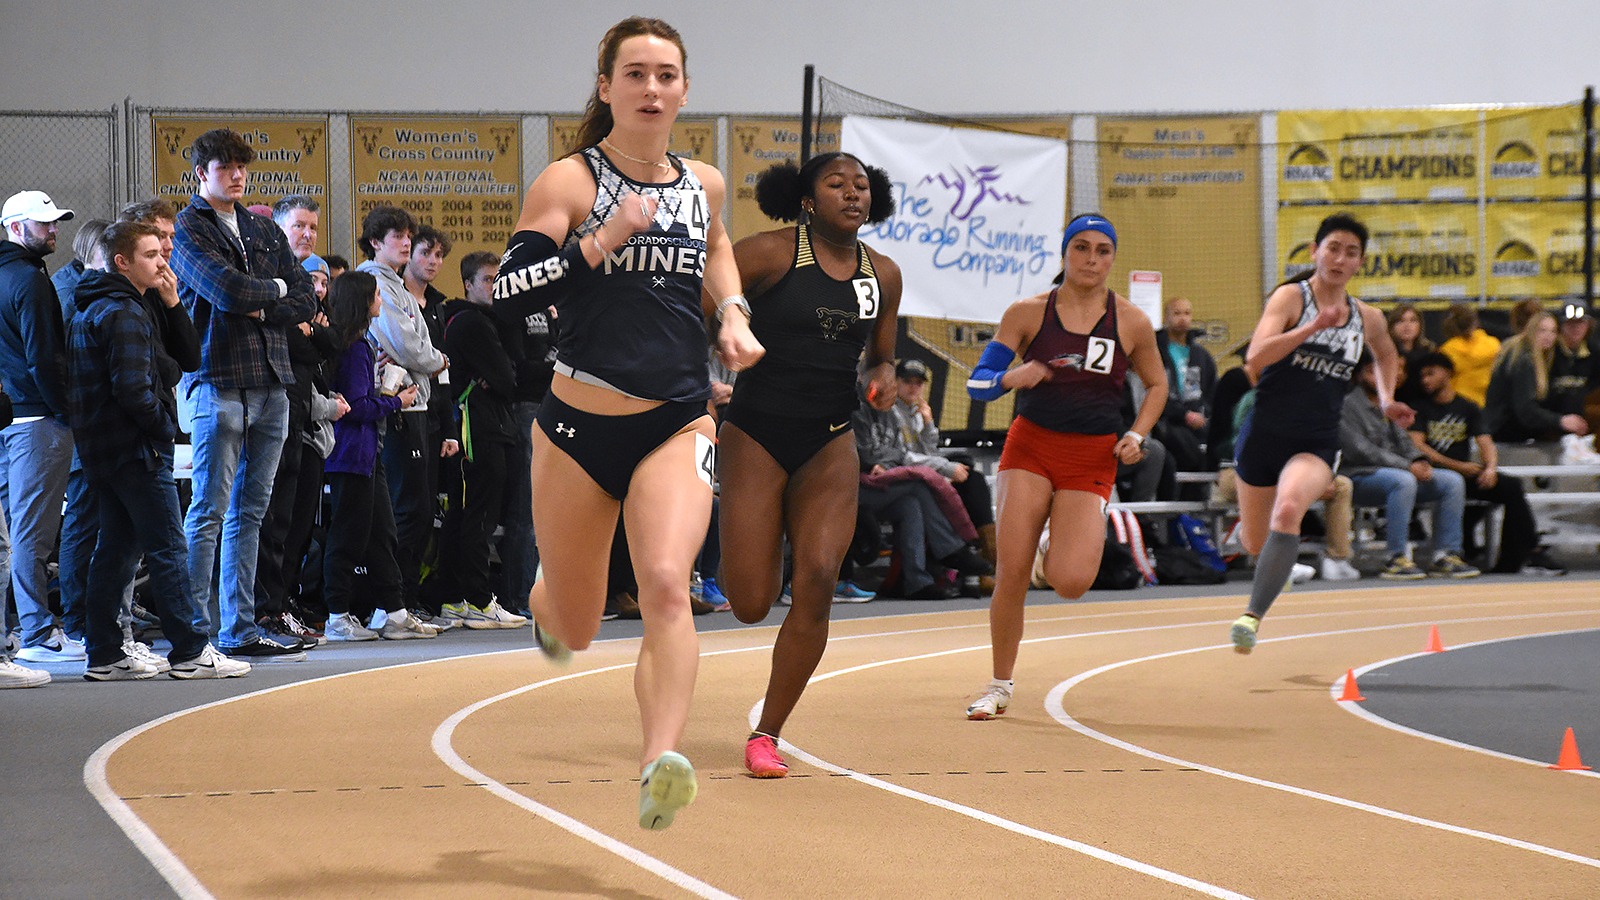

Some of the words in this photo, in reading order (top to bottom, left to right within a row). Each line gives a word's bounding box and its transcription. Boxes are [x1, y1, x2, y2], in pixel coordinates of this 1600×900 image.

[242, 129, 270, 144] n's
[394, 128, 479, 144] Women's
[256, 148, 301, 163] untry
[378, 146, 426, 161] Cross
[431, 146, 495, 163] Country
[378, 170, 418, 182] NCAA
[424, 170, 496, 182] NATIONAL
[1339, 155, 1476, 179] CHAMPIONS
[245, 172, 302, 183] TIONAL
[259, 185, 323, 196] QUALIFIER
[358, 184, 450, 194] CHAMPIONSHIP
[454, 184, 516, 194] QUALIFIER
[442, 200, 473, 211] 2004
[481, 200, 513, 211] 2006
[891, 182, 933, 217] The
[442, 215, 473, 226] 2014
[481, 215, 513, 226] 2016
[691, 194, 706, 238] 4
[449, 230, 473, 241] 019
[967, 215, 1054, 275] Running
[603, 245, 707, 278] MINES
[932, 240, 1025, 296] Company
[1355, 254, 1476, 277] AMPIONS
[859, 281, 876, 317] 3
[1091, 340, 1109, 371] 2
[1291, 353, 1355, 381] MINES
[702, 444, 713, 487] 4
